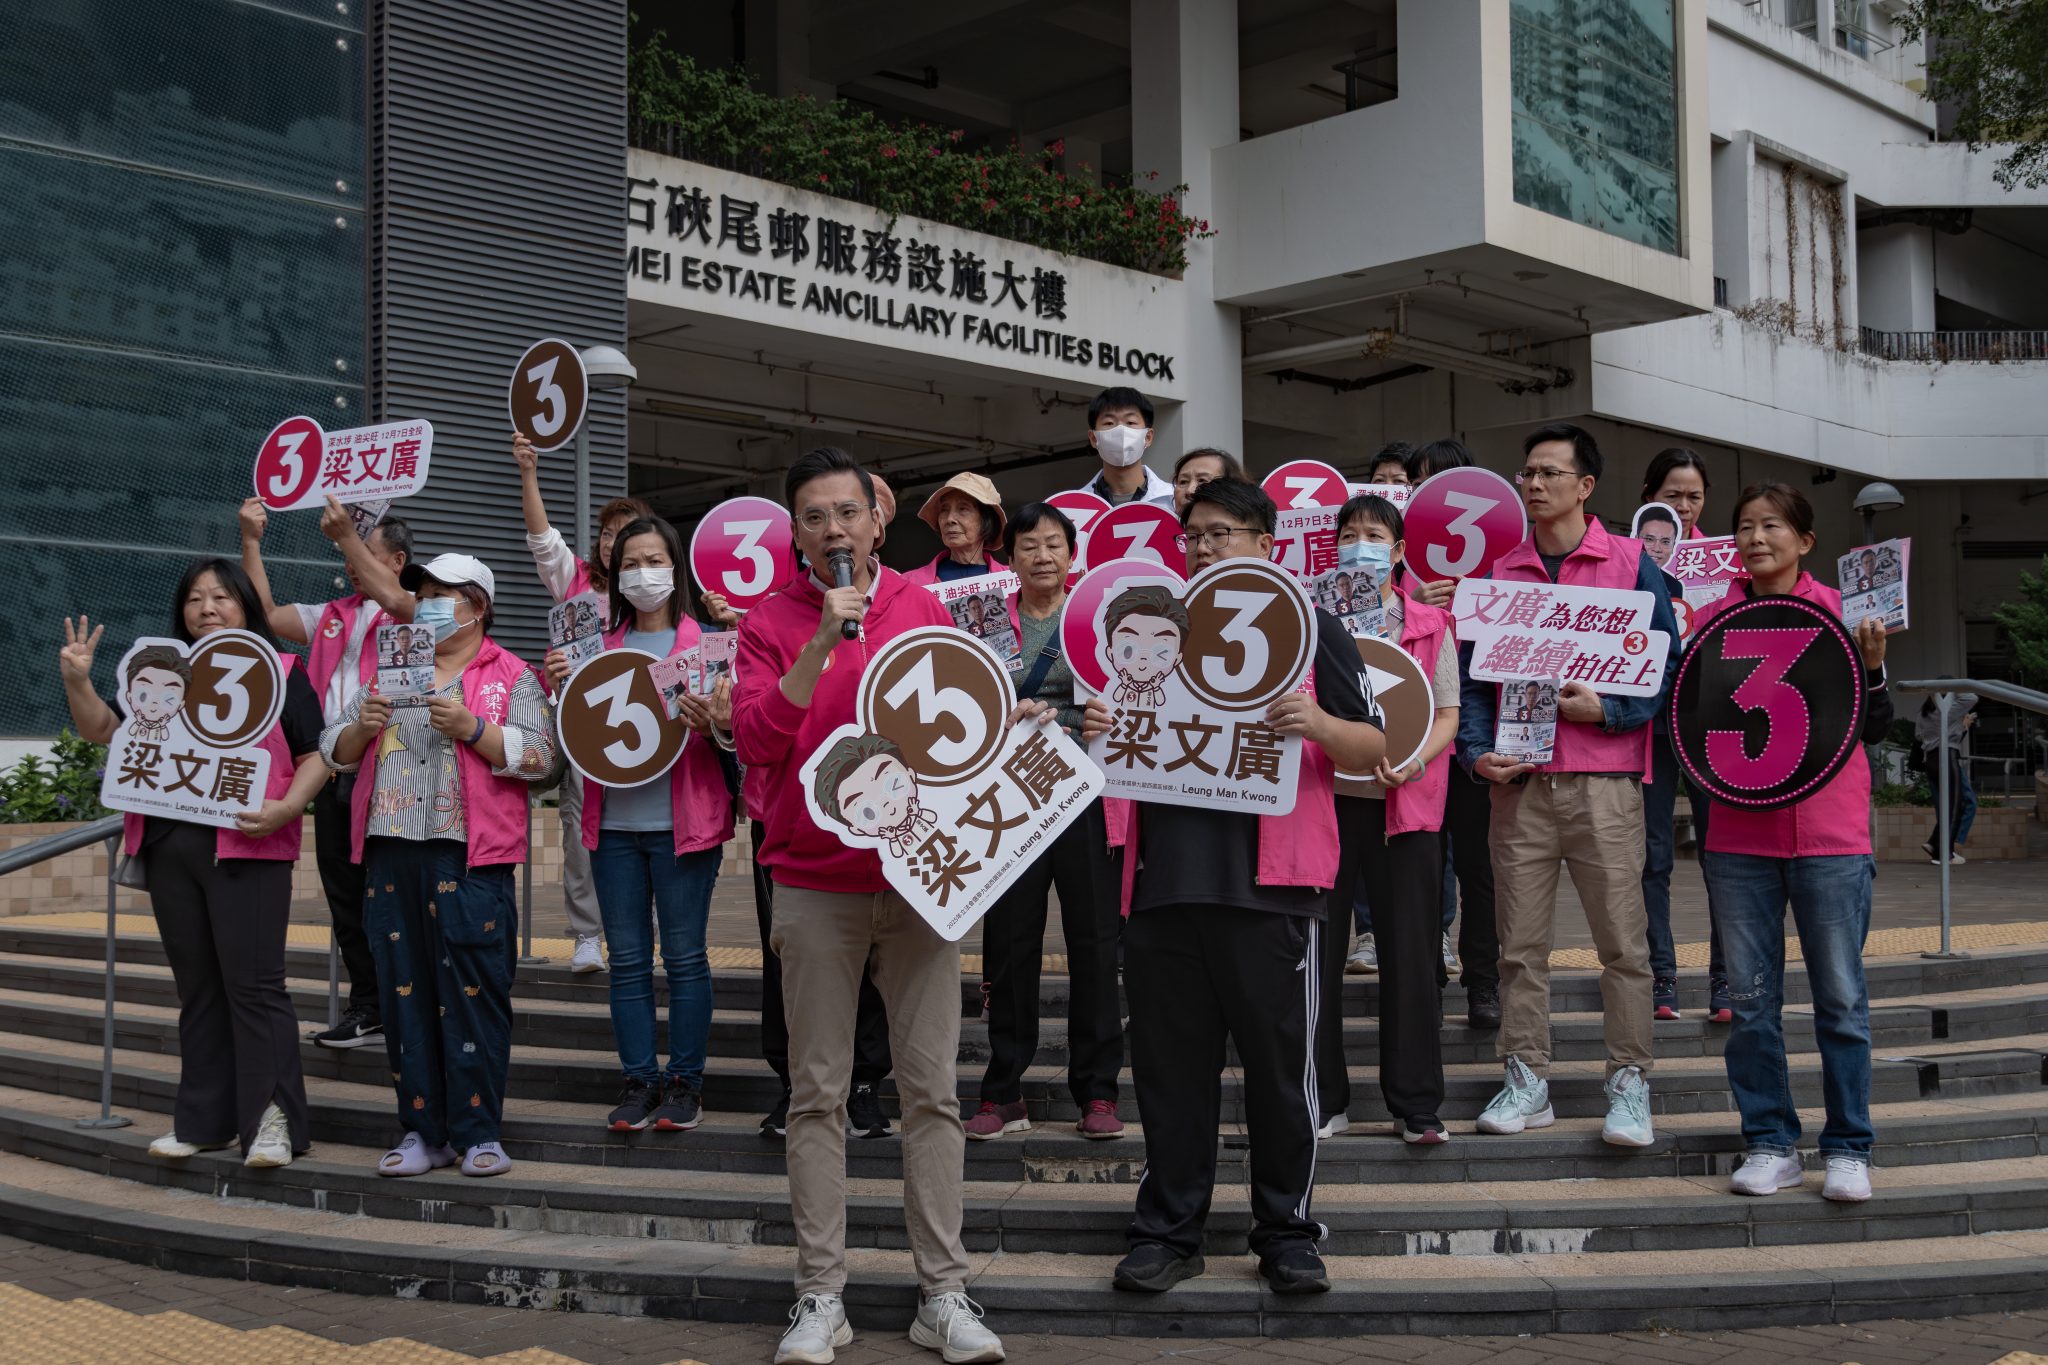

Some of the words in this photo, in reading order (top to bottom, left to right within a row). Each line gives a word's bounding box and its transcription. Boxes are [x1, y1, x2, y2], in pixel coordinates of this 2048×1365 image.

[681, 255, 797, 308] ESTATE
[802, 282, 959, 337] ANCILLARY
[963, 313, 1093, 366] FACILITIES
[1098, 341, 1175, 381] BLOCK
[527, 356, 566, 437] 3
[354, 431, 380, 444] 油尖旺
[381, 426, 423, 440] 12月7日全投
[269, 431, 310, 497] 3
[321, 438, 422, 489] 梁文廣
[722, 519, 774, 596] 3
[1426, 491, 1500, 577] 3
[1675, 543, 1747, 579] 梁文
[1861, 580, 1869, 590] 3
[945, 582, 980, 599] 油尖旺
[1340, 603, 1348, 613] 3
[1457, 585, 1638, 635] 文廣為您想
[323, 618, 344, 638] 3
[566, 631, 573, 641] 3
[728, 638, 738, 650] 3
[972, 626, 981, 636] 3
[1201, 589, 1279, 694] 3
[1626, 632, 1644, 653] 3
[396, 655, 404, 665] 3
[676, 659, 687, 671] 3
[1479, 634, 1657, 687] 繼續拍住上
[198, 652, 260, 735] 3
[584, 668, 661, 768] 3
[883, 649, 987, 766] 3
[1521, 710, 1529, 720] 3
[1706, 627, 1823, 790] 3
[1103, 707, 1286, 784] 梁文廣
[117, 740, 258, 807] 梁文廣
[1181, 783, 1213, 797] Leung
[1216, 787, 1238, 800] Man
[1241, 789, 1278, 804] Kwong
[175, 802, 199, 813] Leung
[201, 806, 218, 816] Man
[906, 729, 1076, 908] 梁文廣
[1012, 830, 1042, 859] Leung
[1041, 809, 1061, 833] Man
[1059, 780, 1091, 812] Kwong
